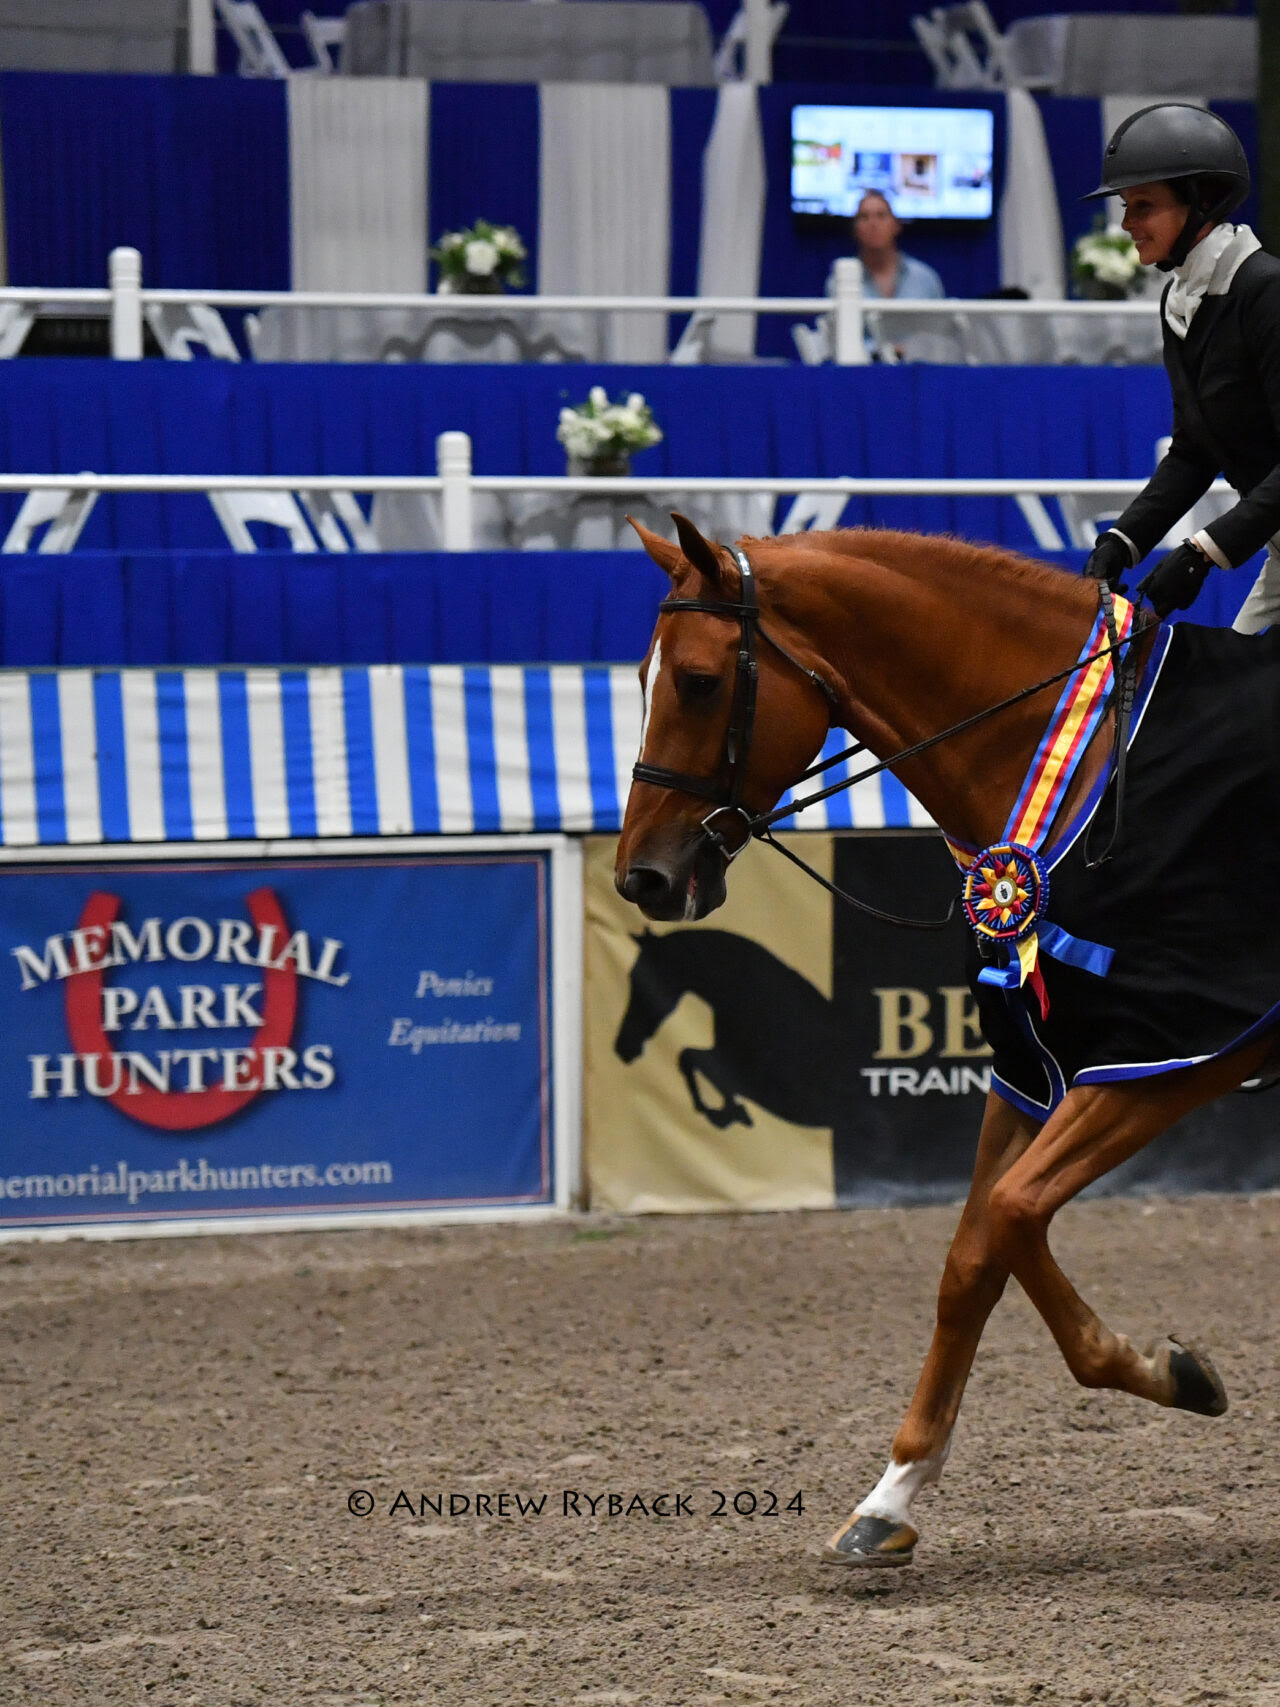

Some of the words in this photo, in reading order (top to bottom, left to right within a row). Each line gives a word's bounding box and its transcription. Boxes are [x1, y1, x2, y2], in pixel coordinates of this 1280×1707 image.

[10, 916, 350, 991] MEMORIAL
[102, 982, 266, 1032] PARK
[416, 969, 494, 998] Ponies
[388, 1016, 522, 1055] Equitation
[28, 1044, 335, 1099] HUNTERS
